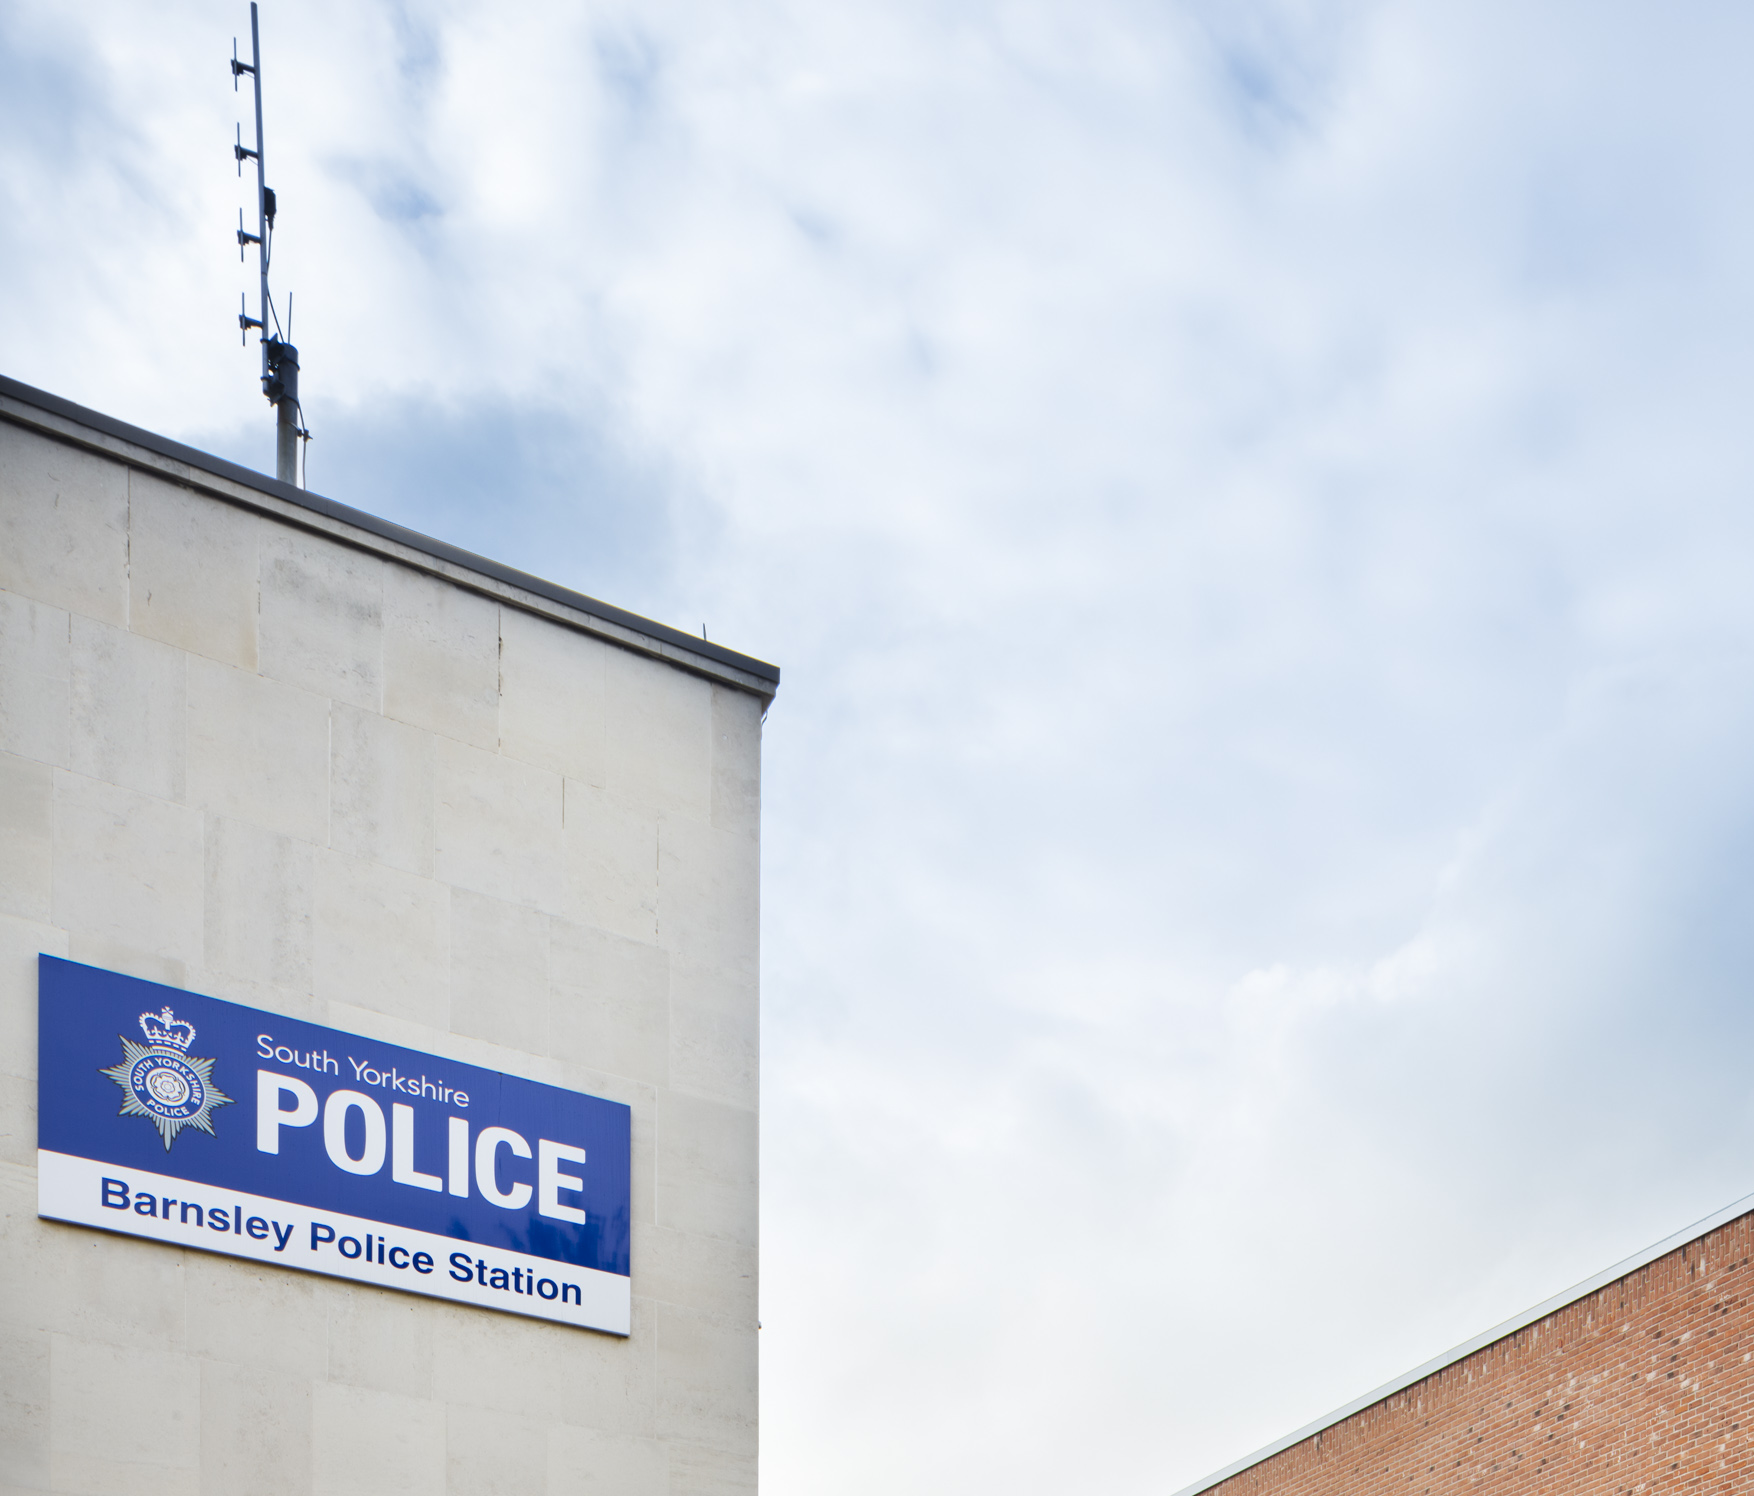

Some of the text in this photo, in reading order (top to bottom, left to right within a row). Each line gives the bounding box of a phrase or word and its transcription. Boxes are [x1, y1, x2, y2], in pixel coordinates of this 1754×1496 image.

[133, 1057, 202, 1105] SOUTH YORKSHIRE
[146, 1098, 190, 1117] POLICE
[256, 1033, 470, 1108] South Yorkshire
[256, 1069, 586, 1226] POLICE
[101, 1176, 582, 1306] Barnsley Police Station
